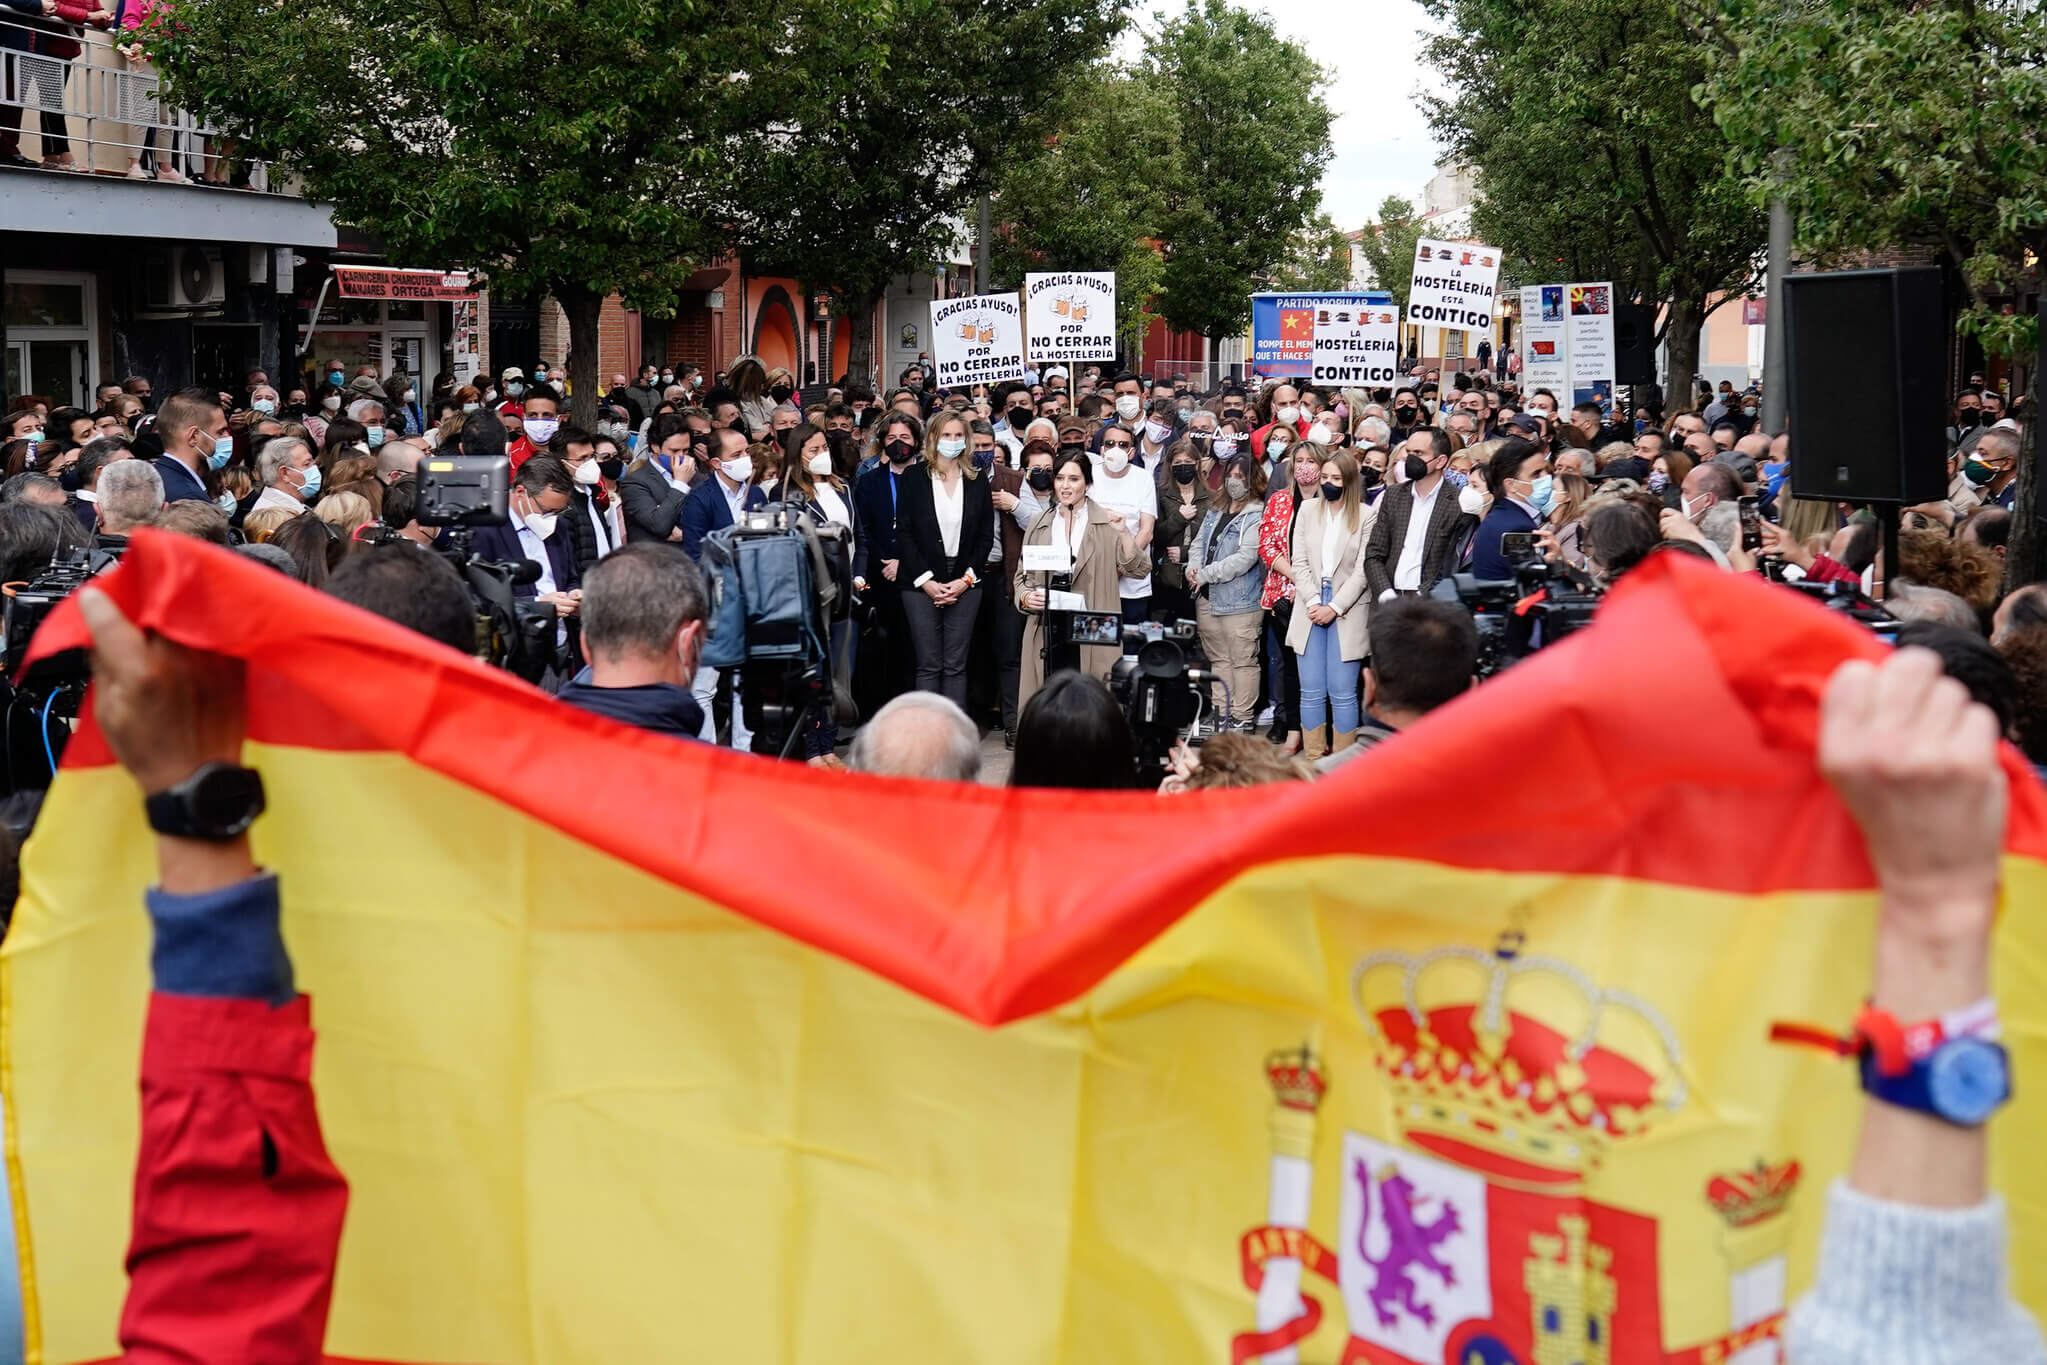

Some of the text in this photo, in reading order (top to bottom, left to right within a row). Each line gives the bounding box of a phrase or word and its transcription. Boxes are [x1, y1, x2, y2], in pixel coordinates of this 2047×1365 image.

[342, 271, 390, 284] CARNICERIA
[391, 276, 441, 286] CHARCUTERIA
[1450, 270, 1461, 278] LA
[343, 283, 386, 296] MANJARES
[392, 286, 434, 297] ORTEGA
[1029, 275, 1113, 299] ¡GRACIAS AYUSO!
[1414, 276, 1492, 297] HOSTELERÍA
[1277, 299, 1319, 308] PARTIDO
[934, 298, 1018, 328] ¡GRACIAS AYUSO!
[1410, 304, 1489, 328] CONTIGO
[1060, 324, 1083, 333] POR
[1032, 336, 1112, 348] NO CERRAR
[1258, 340, 1284, 348] ROMPE
[1286, 340, 1295, 348] EL
[1315, 338, 1395, 351] HOSTELERÍA
[968, 347, 991, 357] POR
[1030, 348, 1113, 360] LA HOSTELERÍA
[1256, 352, 1271, 360] QUE
[1272, 352, 1281, 360] TE
[1283, 352, 1303, 360] HACE
[940, 355, 1020, 373] NO CERRAR
[940, 368, 1023, 386] LA HOSTELERÍA
[1314, 366, 1394, 381] CONTIGO
